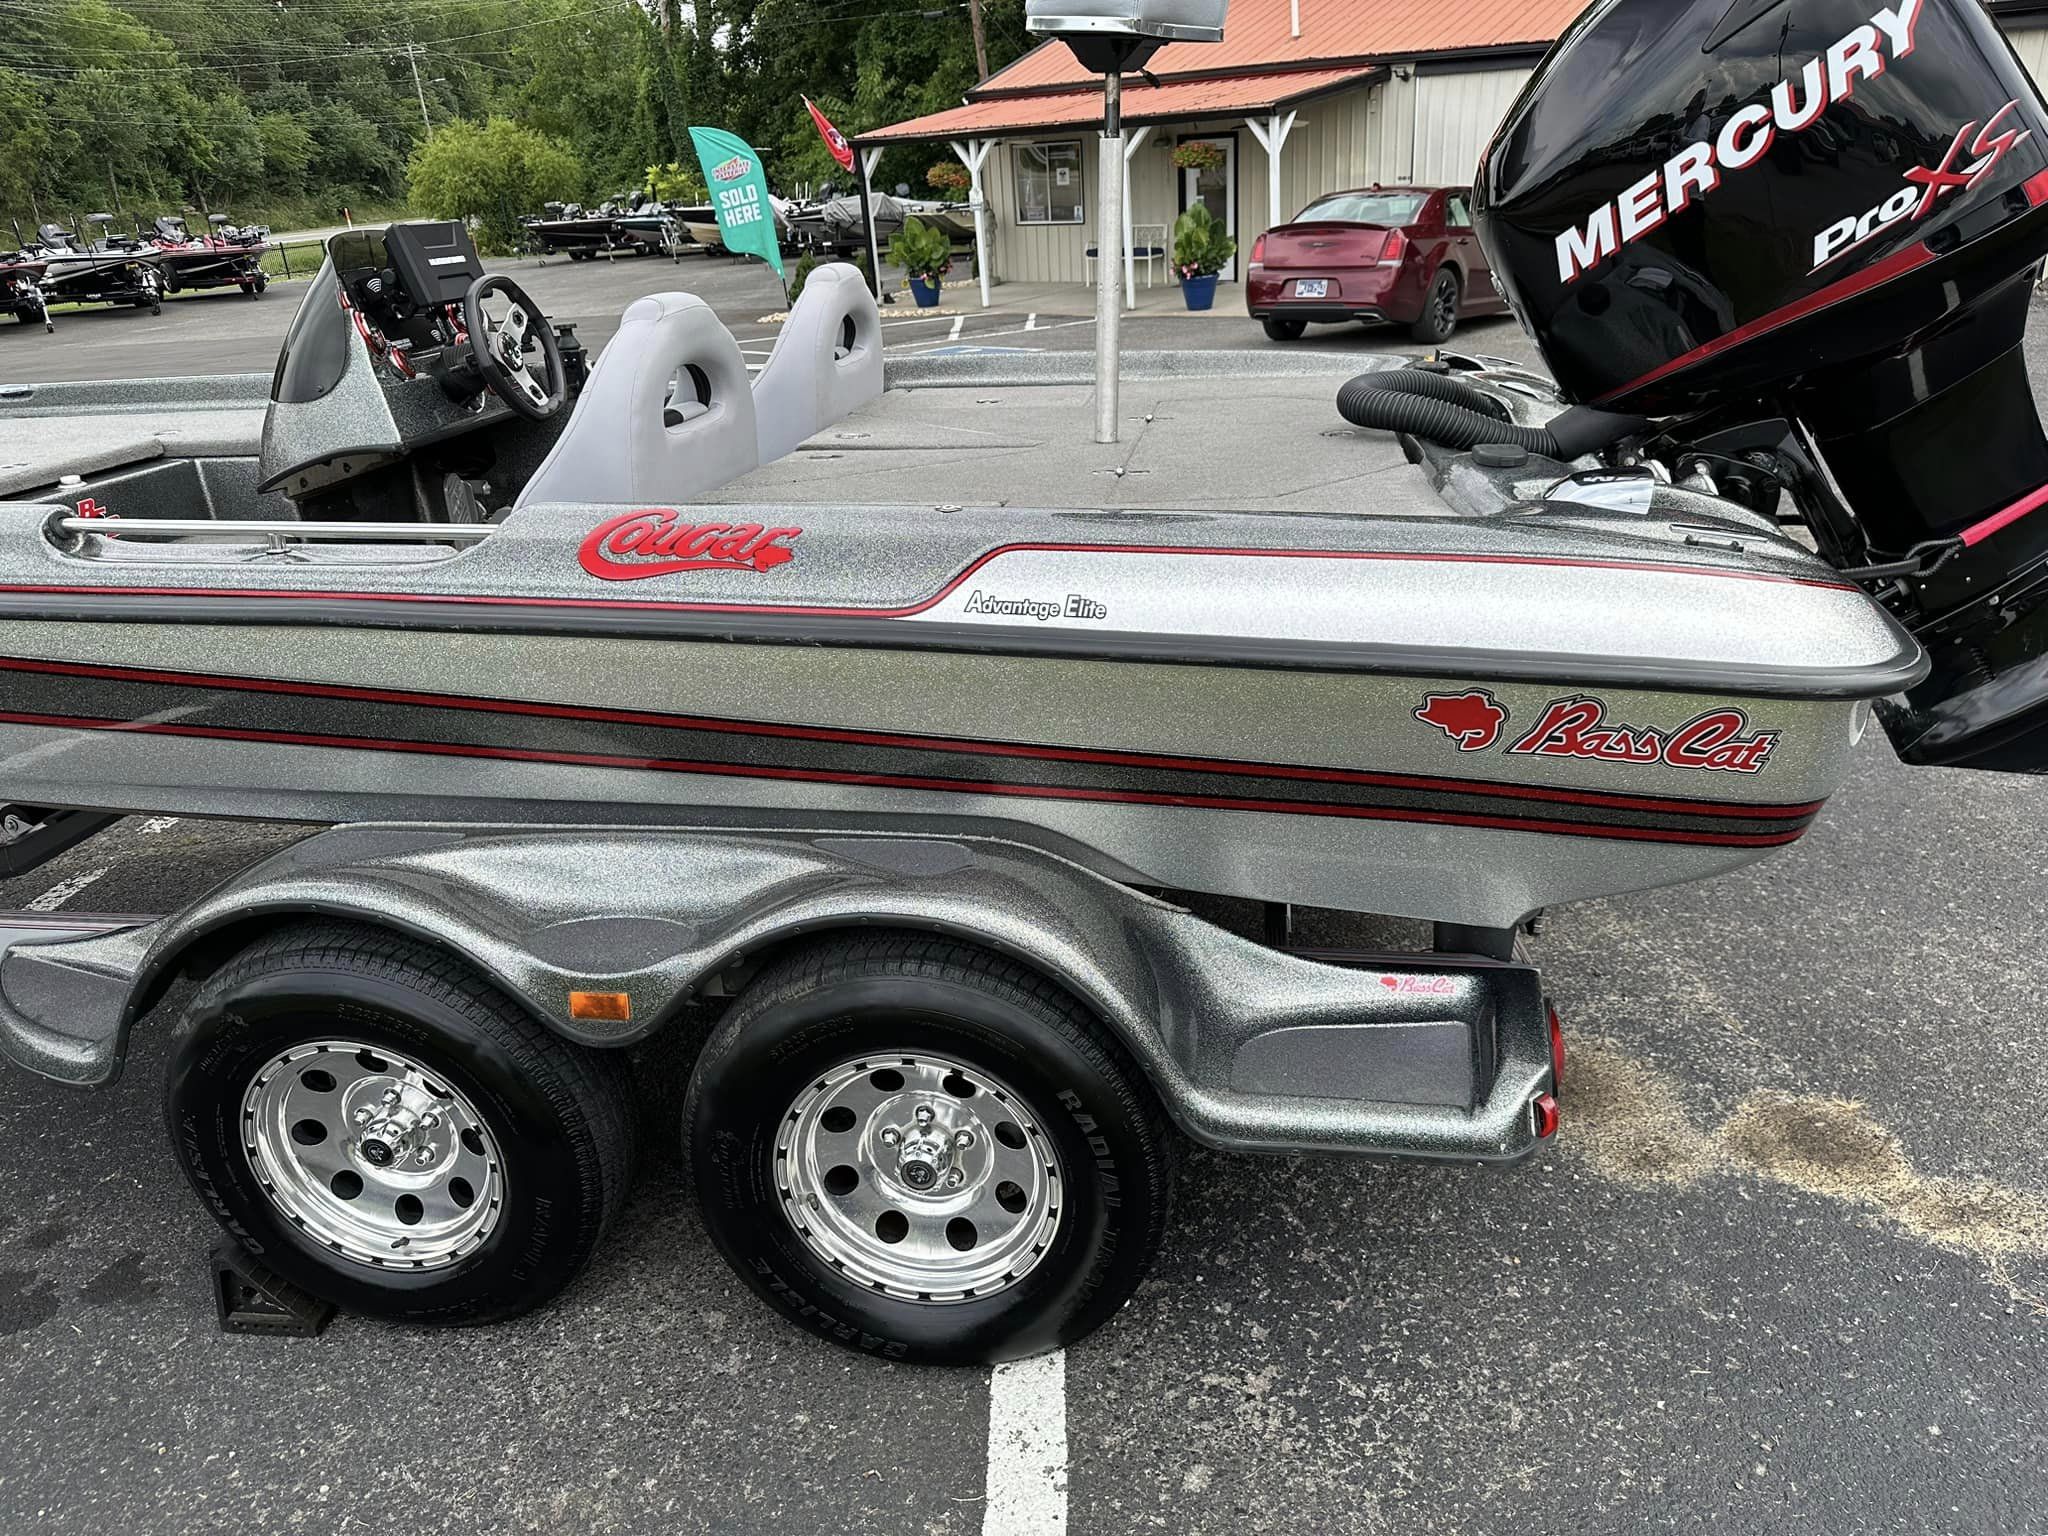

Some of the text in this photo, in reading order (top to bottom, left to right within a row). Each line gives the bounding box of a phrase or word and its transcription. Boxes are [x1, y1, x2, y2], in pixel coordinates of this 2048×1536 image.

[1555, 0, 1922, 283] MERCURY
[719, 184, 758, 209] SOLD
[724, 202, 762, 228] HERE
[578, 508, 803, 581] Cougar
[965, 590, 1107, 620] Advantage Elite
[1503, 695, 1782, 776] Bass Cat
[1055, 1088, 1122, 1208] RADIAL
